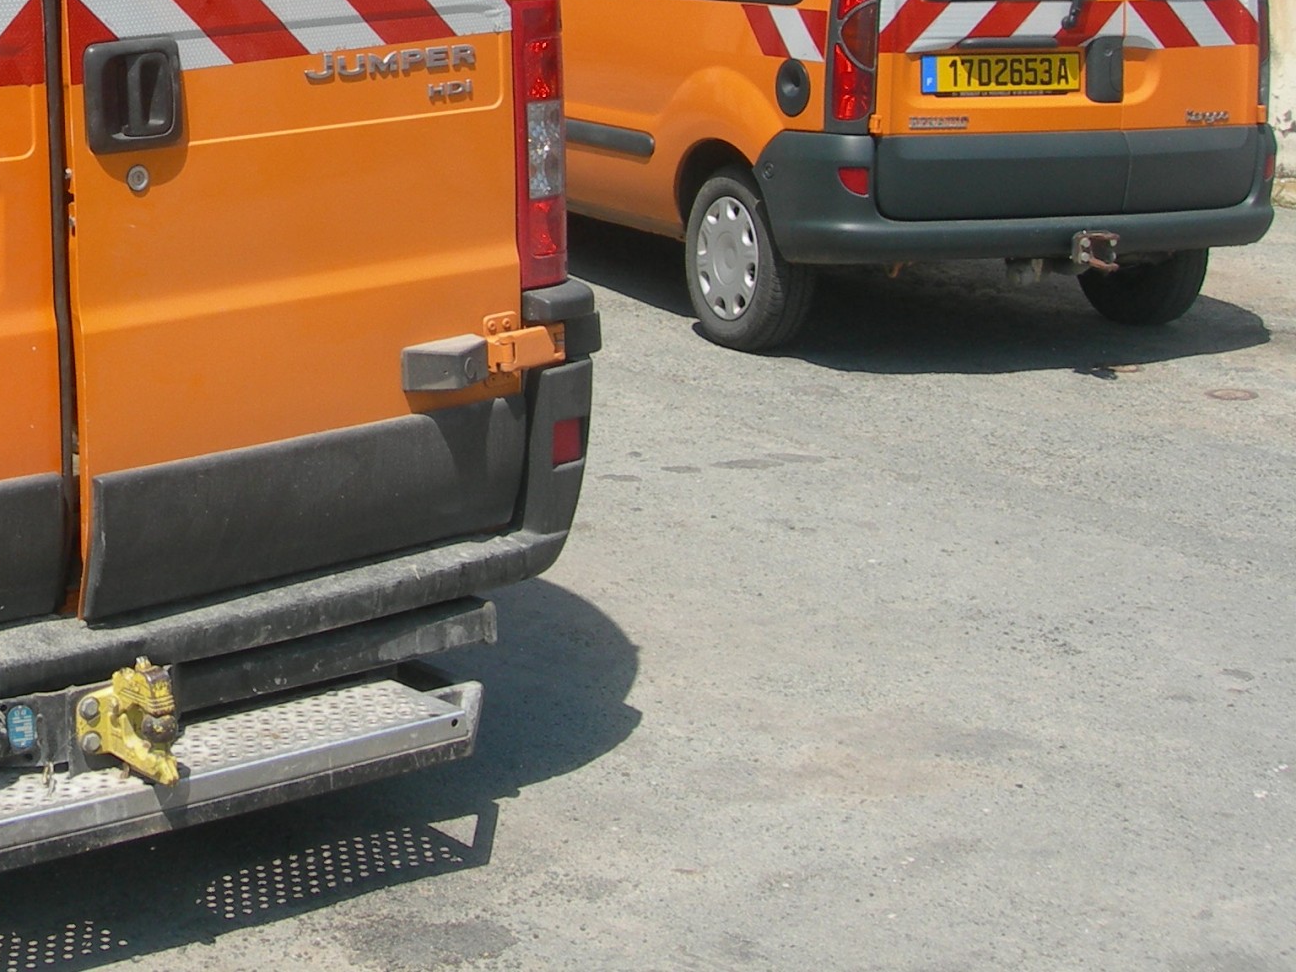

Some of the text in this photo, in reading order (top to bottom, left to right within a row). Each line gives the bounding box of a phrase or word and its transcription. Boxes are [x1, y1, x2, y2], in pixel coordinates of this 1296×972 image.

[304, 44, 476, 79] JUMPER
[949, 58, 1070, 87] 17D2653A
[926, 77, 933, 86] F
